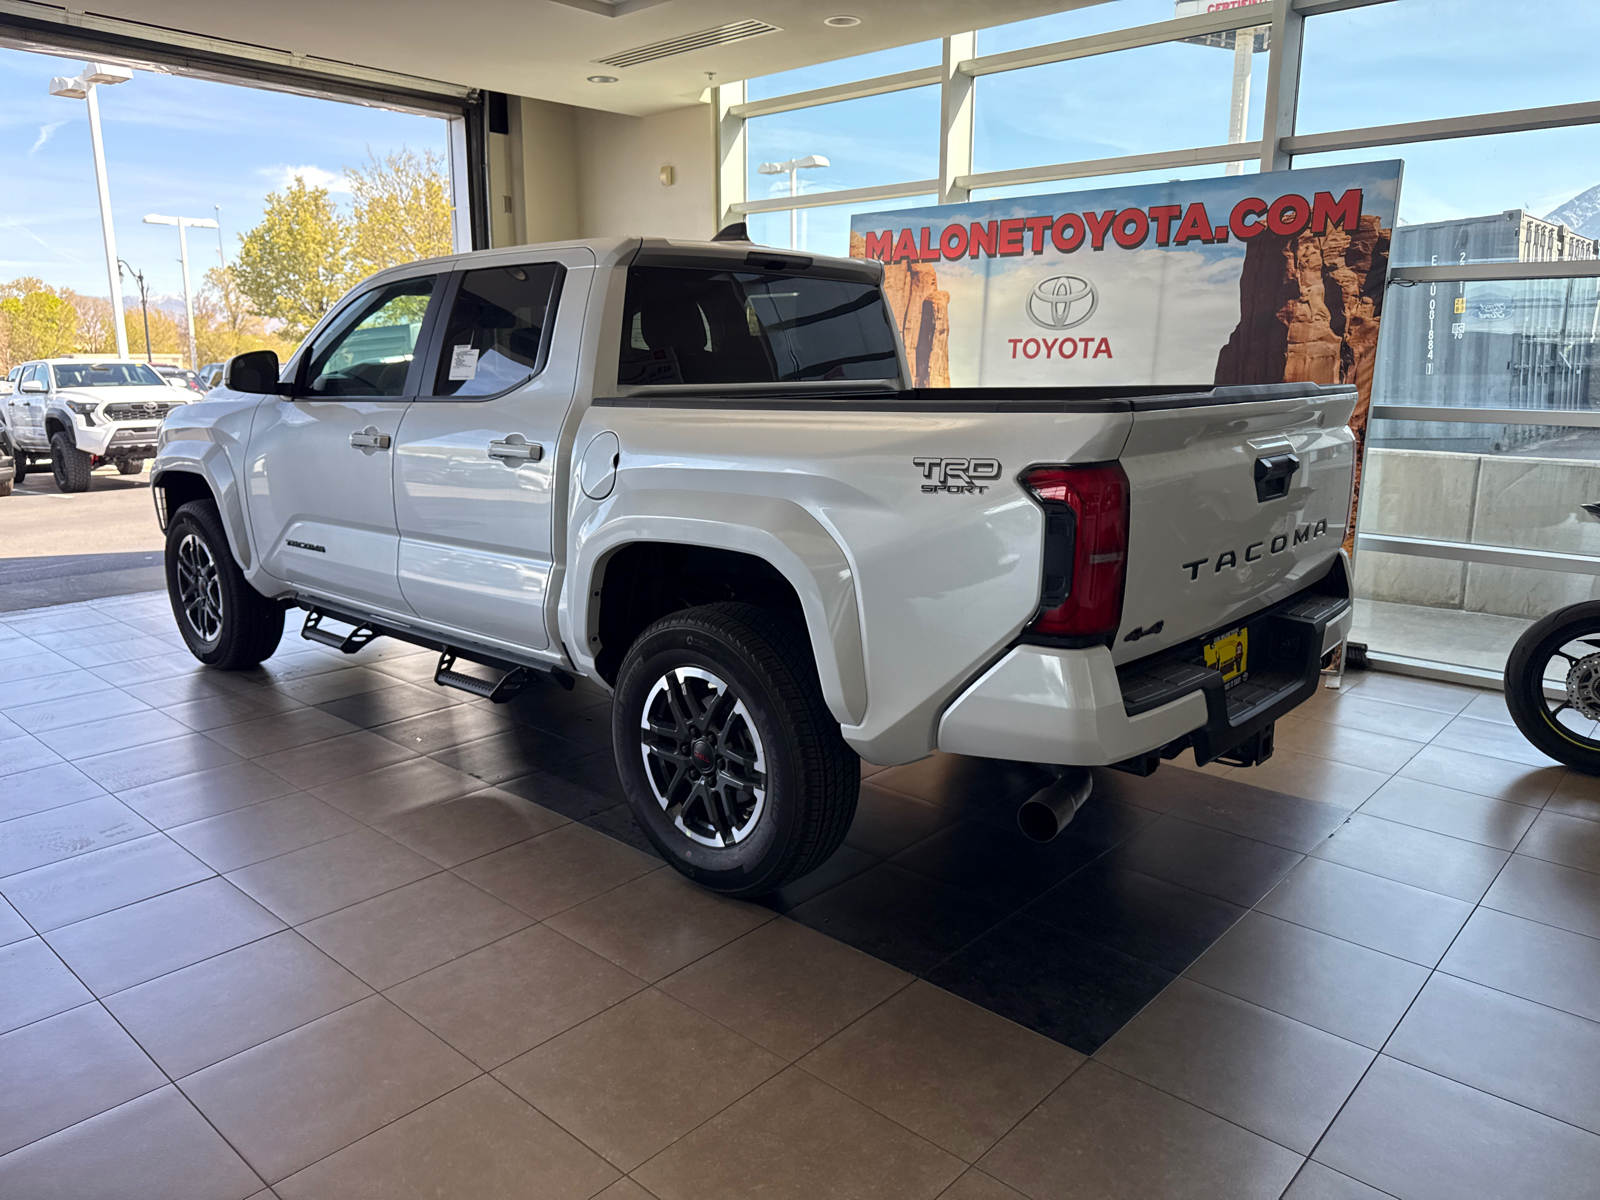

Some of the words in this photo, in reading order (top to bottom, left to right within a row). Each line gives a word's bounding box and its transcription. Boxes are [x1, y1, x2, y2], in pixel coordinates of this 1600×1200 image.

[864, 188, 1364, 265] MALONETOYOTA.COM
[1008, 337, 1113, 360] TOYOTA
[912, 457, 1003, 486] TRD
[920, 484, 990, 496] SPORT
[1182, 518, 1328, 581] TACOMA
